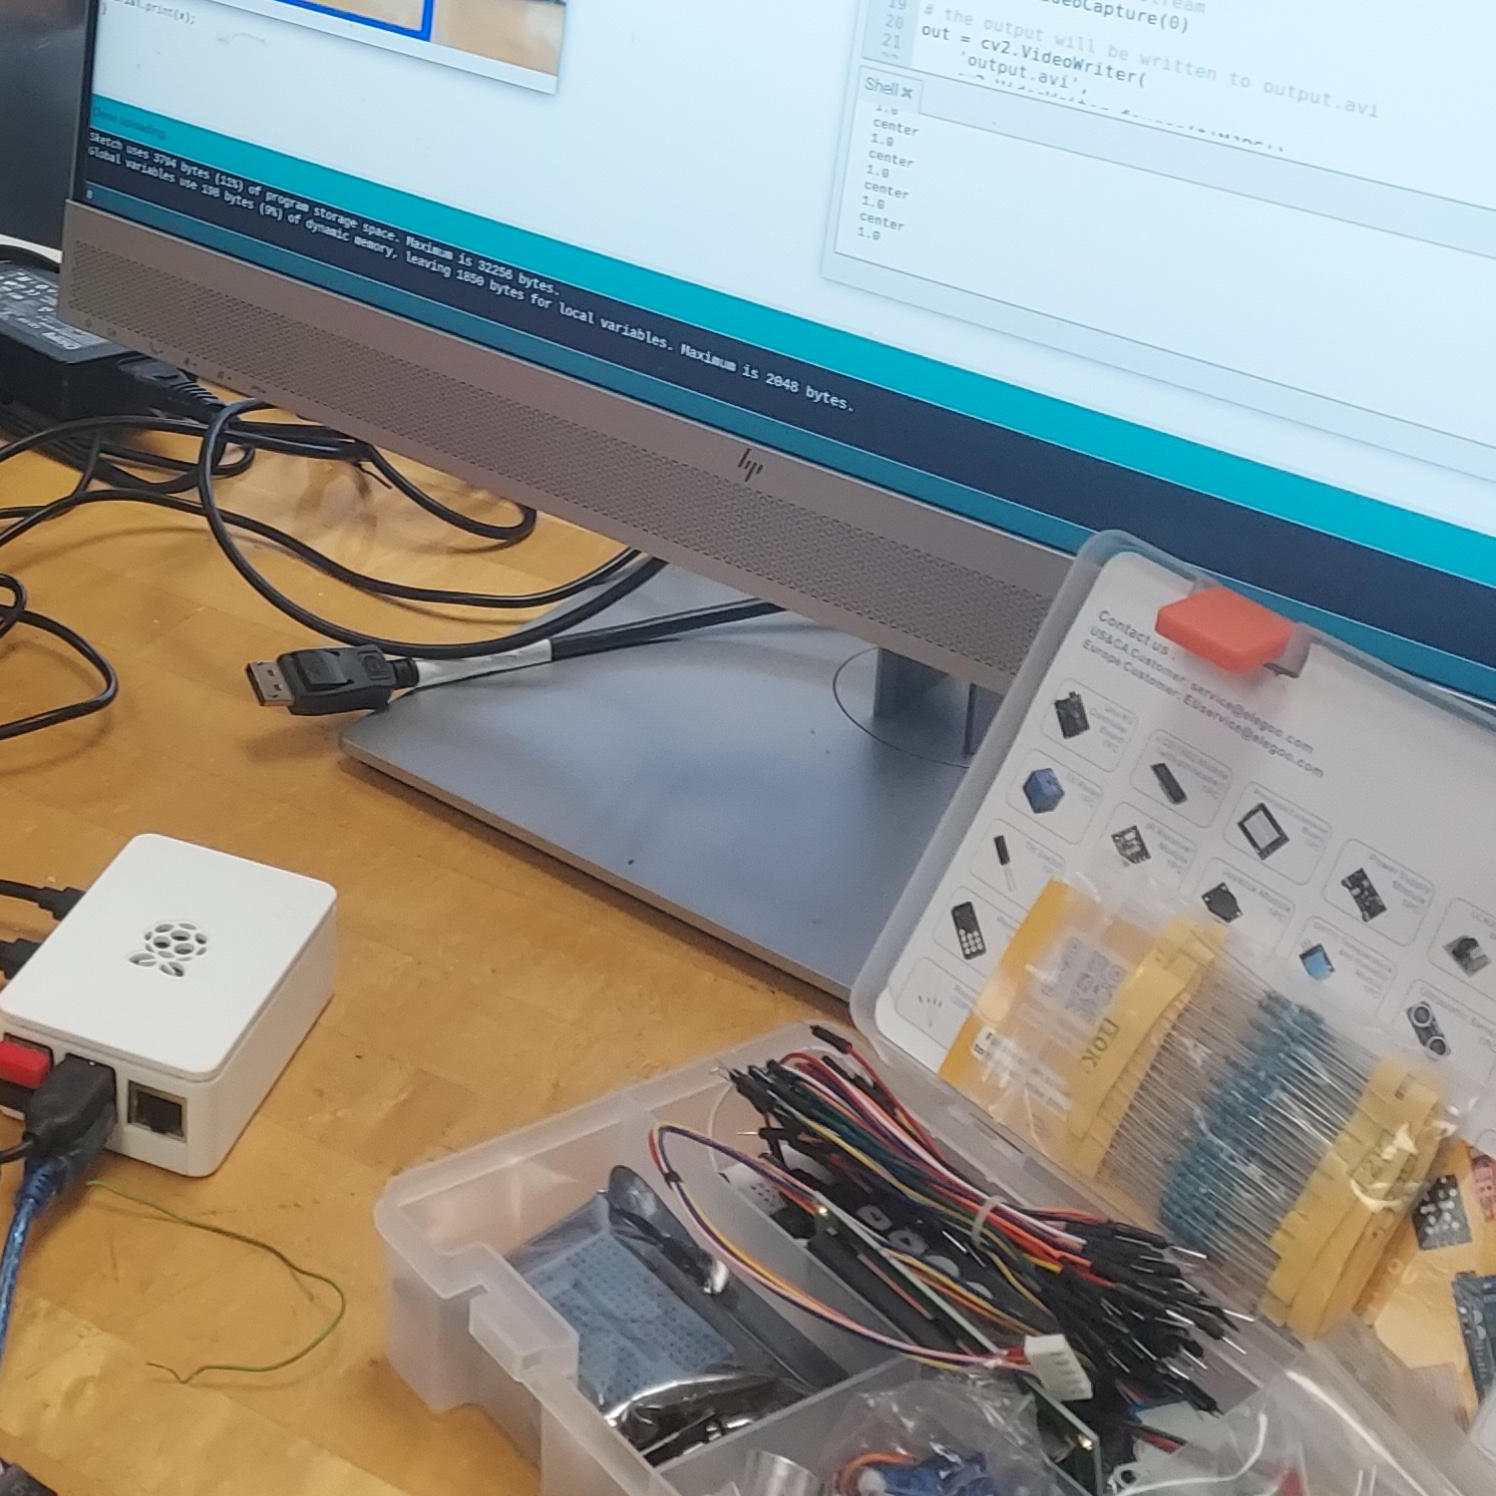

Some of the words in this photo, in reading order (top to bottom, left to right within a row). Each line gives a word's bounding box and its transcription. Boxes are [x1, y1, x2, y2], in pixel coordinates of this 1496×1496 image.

[922, 26, 949, 40] out
[981, 40, 1144, 87] cv2.VideoWriter(
[945, 7, 973, 25] the
[984, 20, 1044, 41] output
[1055, 35, 1095, 53] will
[1108, 42, 1128, 60] be
[1140, 54, 1216, 80] written
[1230, 70, 1250, 88] to
[1264, 82, 1378, 118] output.avi
[865, 75, 898, 96] Shell
[874, 119, 918, 135] center
[869, 150, 914, 167] center
[864, 182, 909, 198] center
[89, 131, 123, 151] Sketch
[127, 146, 149, 159] uses
[181, 160, 209, 179] bytes
[248, 179, 262, 195] of
[265, 190, 310, 213] program
[314, 208, 358, 228] storage
[363, 224, 399, 242] space.
[406, 234, 453, 259] Maximum
[458, 251, 472, 266] is
[519, 271, 559, 295] bytes.
[860, 213, 904, 230] center
[89, 145, 120, 164] Global
[126, 160, 175, 182] variables
[180, 178, 197, 189] use
[225, 189, 254, 209] bytes
[288, 215, 301, 224] of
[306, 218, 349, 241] dynamic
[354, 237, 397, 258] memory,
[407, 250, 451, 277] leaving
[490, 277, 524, 299] bytes
[531, 292, 552, 308] for
[560, 300, 594, 324] local
[601, 319, 672, 350] variables.
[681, 342, 736, 371] Maximum
[743, 363, 758, 378] is
[766, 373, 798, 392] 2048
[806, 383, 853, 411] bytes.
[1098, 610, 1149, 645] Contact
[1151, 635, 1168, 654] us
